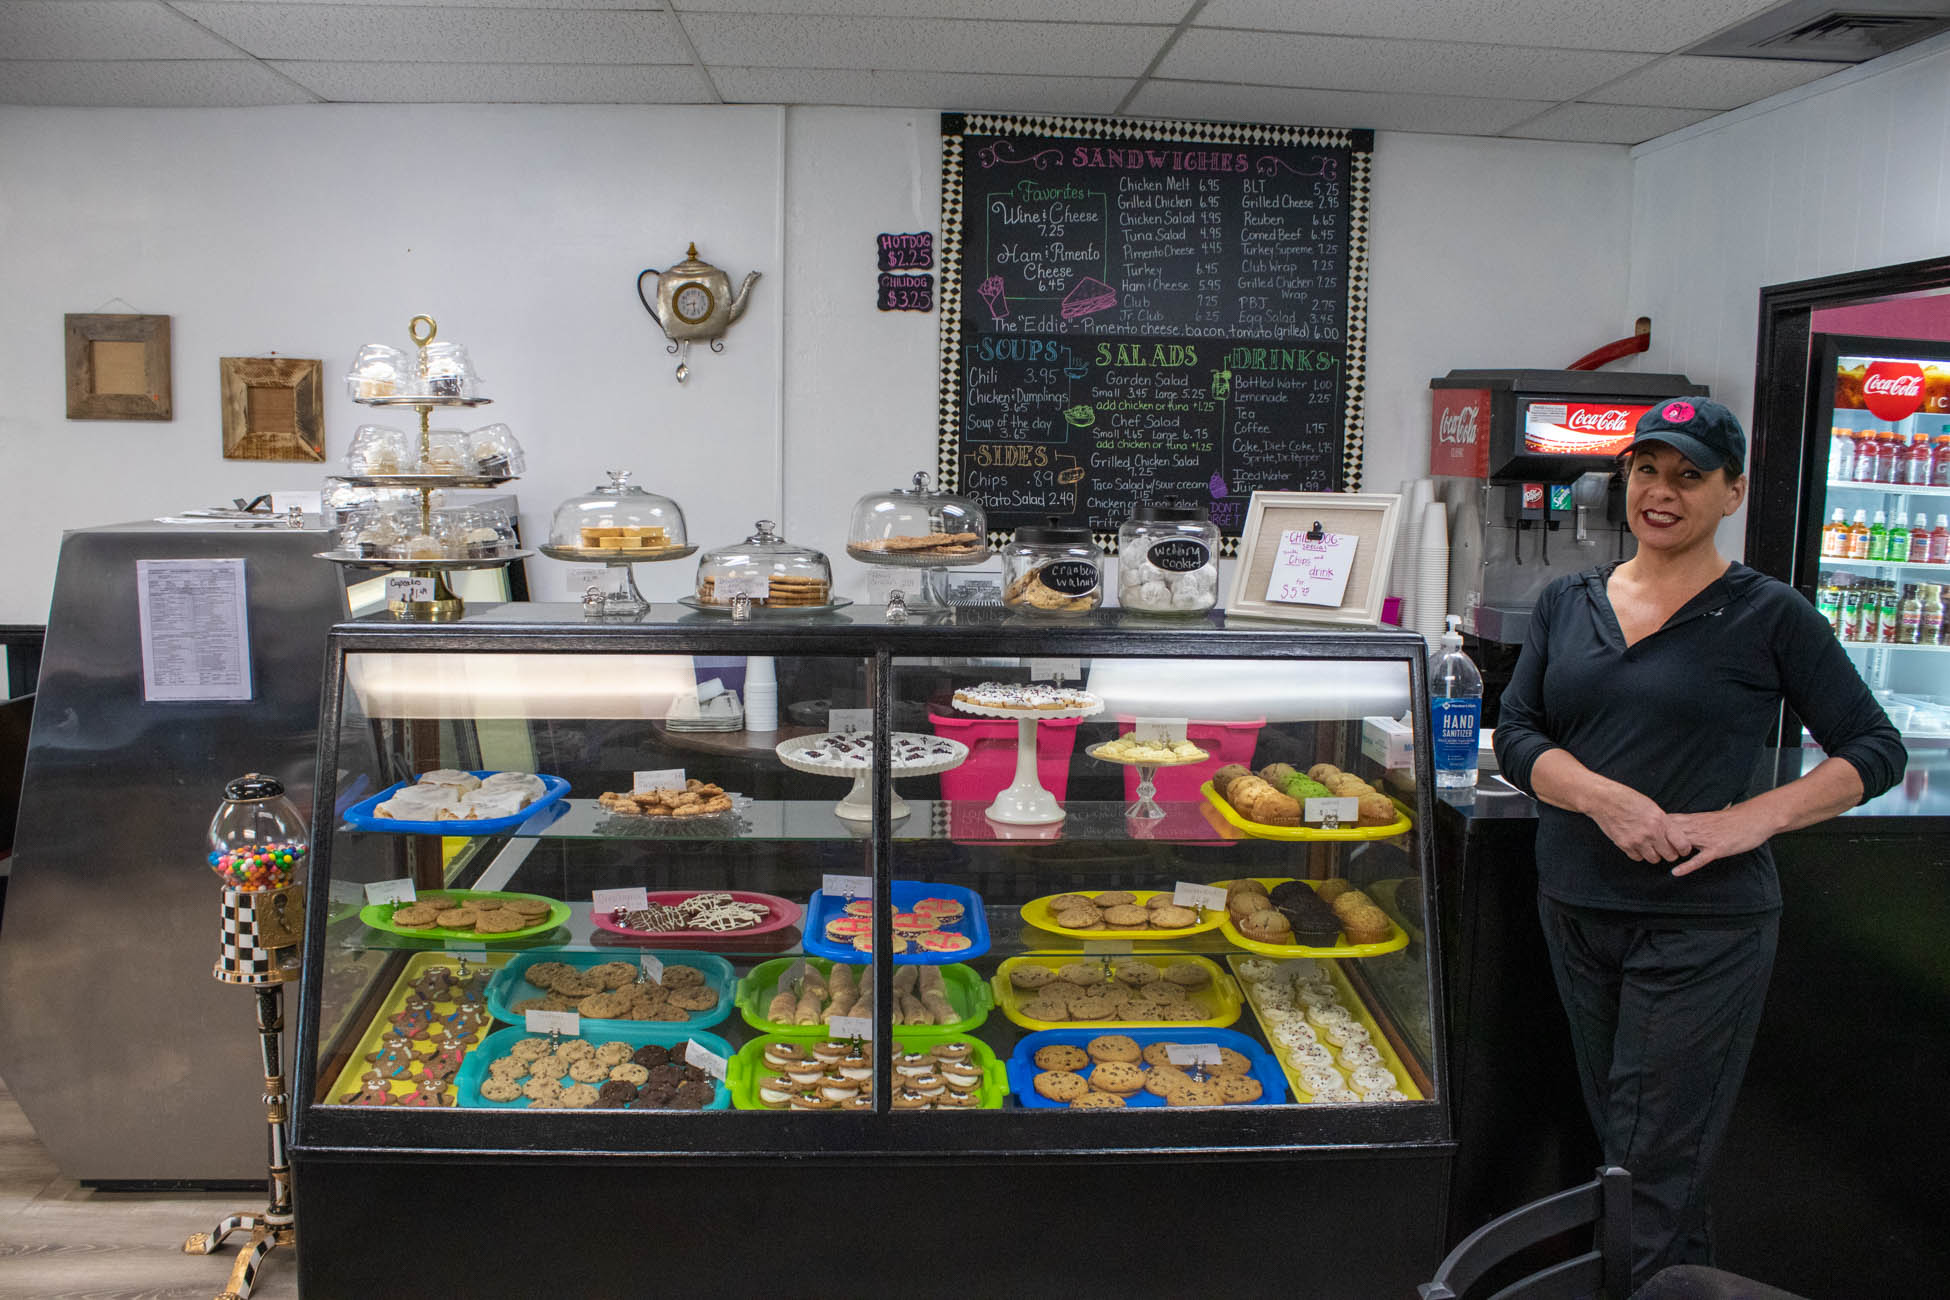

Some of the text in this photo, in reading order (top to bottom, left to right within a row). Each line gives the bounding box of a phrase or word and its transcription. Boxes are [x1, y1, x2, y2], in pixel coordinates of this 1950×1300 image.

[1072, 147, 1249, 172] SANDWICHES
[1018, 180, 1084, 202] Favorites
[1120, 176, 1220, 192] Chicken Melt 6.95
[1243, 179, 1266, 193] BLT
[1118, 194, 1220, 209] Grilled Chicken 6.95
[1242, 194, 1339, 209] Grilled Cheese 2.95
[992, 201, 1099, 224] Wine Cheese
[1120, 211, 1221, 226] Chicken Salad 4.95
[1244, 211, 1336, 226] Reuben 6.65
[1037, 225, 1065, 237] 7.25
[1122, 227, 1221, 242] Tuna Salad 4.95
[1241, 228, 1335, 241] Corned Beef 6.45
[882, 234, 931, 250] HOTDOG
[888, 248, 931, 268] $2.25
[997, 243, 1042, 263] Ham
[1122, 244, 1164, 260] Pimento
[1164, 244, 1195, 257] Cheese
[1241, 242, 1274, 259] Turkey
[1275, 243, 1313, 261] Supreme
[1024, 262, 1074, 280] Cheese
[1122, 263, 1162, 279] Turkey
[1242, 259, 1267, 272] Club
[1269, 260, 1298, 277] Wrap
[1038, 279, 1065, 292] 6.45
[1122, 280, 1146, 292] Ham
[1153, 278, 1190, 291] Cheese
[1238, 277, 1274, 289] Grilled
[1276, 276, 1314, 289] Chicken
[888, 289, 931, 309] $3.25
[1123, 294, 1150, 308] Club
[1239, 296, 1336, 311] PBJ 2.75
[1281, 289, 1308, 304] Wrap
[1138, 309, 1164, 321] Club
[1239, 309, 1334, 326] Egg Salad 3.45
[992, 317, 1017, 332] The
[1080, 316, 1138, 335] Pimento
[1229, 323, 1272, 338] tomato
[1274, 321, 1309, 340] (grilled)
[1313, 325, 1339, 340] 6.00
[980, 337, 1058, 361] SOUPS
[1095, 342, 1198, 366] SALADS
[1231, 347, 1330, 371] DRINKS
[969, 366, 1060, 387] Chili 3.95
[1105, 370, 1189, 387] Garden Salad
[1235, 375, 1274, 389] Bottled
[1277, 377, 1308, 389] Water
[1864, 374, 1923, 396] Coca-Cola
[969, 386, 1069, 411] Chicken Dumplings
[1092, 386, 1120, 398] Small
[1155, 388, 1178, 400] Large
[1181, 388, 1206, 399] 5.25
[1234, 391, 1332, 404] Lemonade 2.25
[1001, 402, 1031, 413] 3.65
[1096, 400, 1116, 411] add
[1118, 400, 1153, 411] chicken
[1155, 403, 1165, 411] or
[1167, 400, 1189, 411] tuna
[1235, 406, 1256, 419] Tea
[967, 413, 1052, 437] Soup of the day
[1111, 413, 1180, 429] Chef Salad
[1440, 406, 1479, 444] Coca-Cola
[1568, 408, 1630, 431] Coca-Cola
[1000, 427, 1030, 439] 3.65
[1092, 427, 1120, 439] Small
[1152, 430, 1179, 441] Large
[1234, 421, 1328, 434] Coffee 1.75
[1096, 440, 1114, 449] add
[1117, 439, 1150, 449] chicken
[1152, 441, 1163, 449] or
[1165, 439, 1188, 450] tuna
[977, 444, 1048, 467] SIDES
[1090, 452, 1199, 467] Grilled Chicken Salad
[1128, 467, 1157, 477] 7.25
[1232, 468, 1260, 481] Iced
[1262, 470, 1294, 481] Water
[968, 470, 1008, 490] Chips
[1026, 470, 1054, 487] .89
[1091, 478, 1113, 490] Taco
[1115, 478, 1144, 490] Salad
[1176, 481, 1209, 489] cream
[1232, 481, 1264, 493] Juice
[1012, 490, 1046, 507] Salad
[1048, 491, 1074, 506] 2.49
[1087, 498, 1128, 508] Chicken
[1309, 566, 1333, 577] drink
[1443, 714, 1474, 728] HAND
[1442, 729, 1472, 737] SANITIZER
